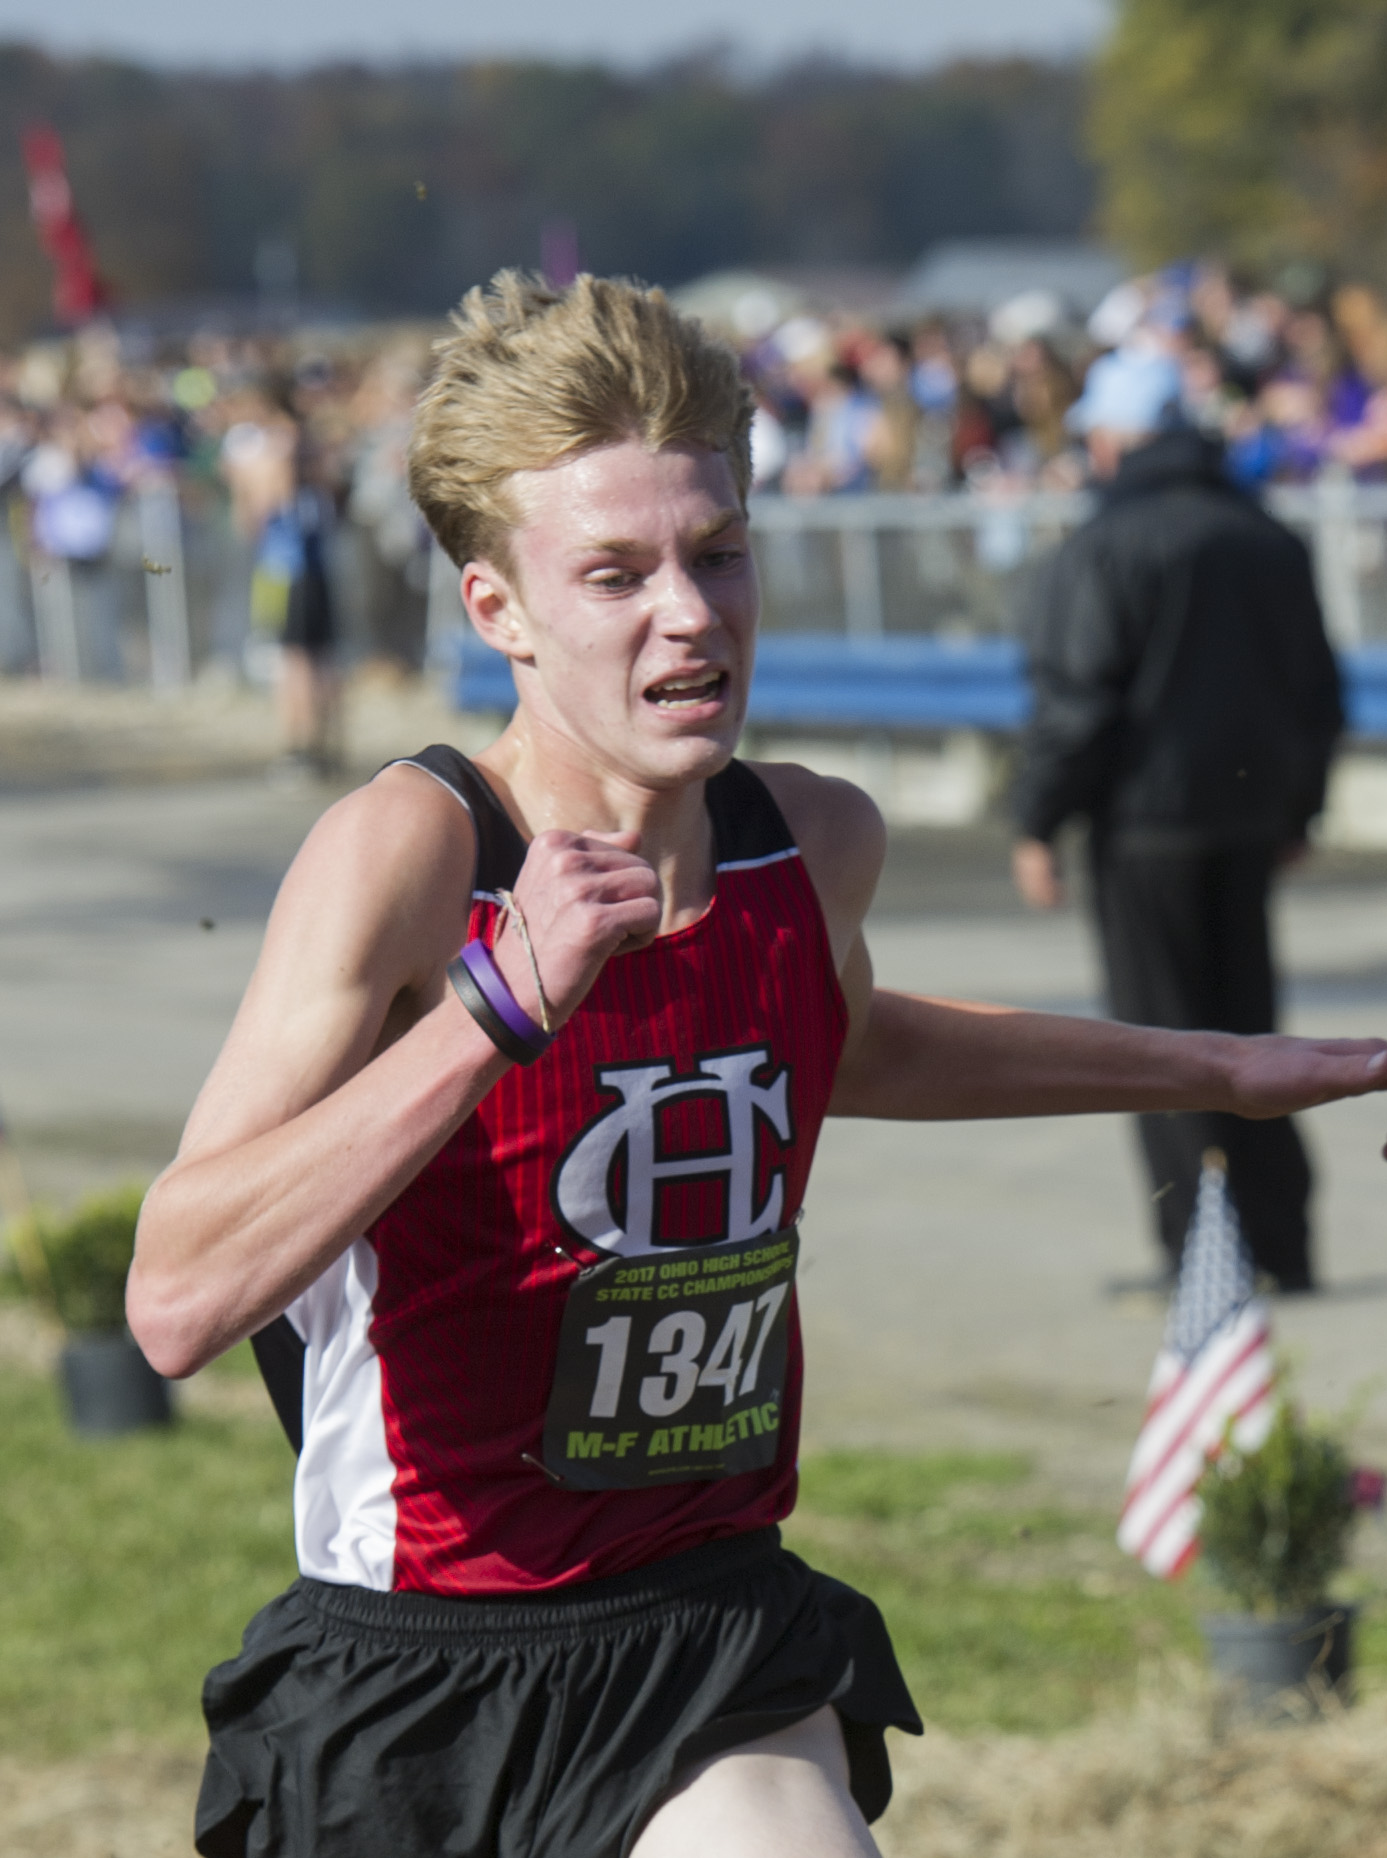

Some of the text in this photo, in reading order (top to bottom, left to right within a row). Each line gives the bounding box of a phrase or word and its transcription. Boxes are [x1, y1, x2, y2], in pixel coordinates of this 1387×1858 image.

[596, 1255, 795, 1301] STATE CC CHAMPIONSHIPS
[615, 1241, 790, 1285] 2017 OHIO HIGH SCHOOL
[585, 1281, 789, 1418] 1347
[566, 1402, 780, 1459] M-F ATHLETIC
